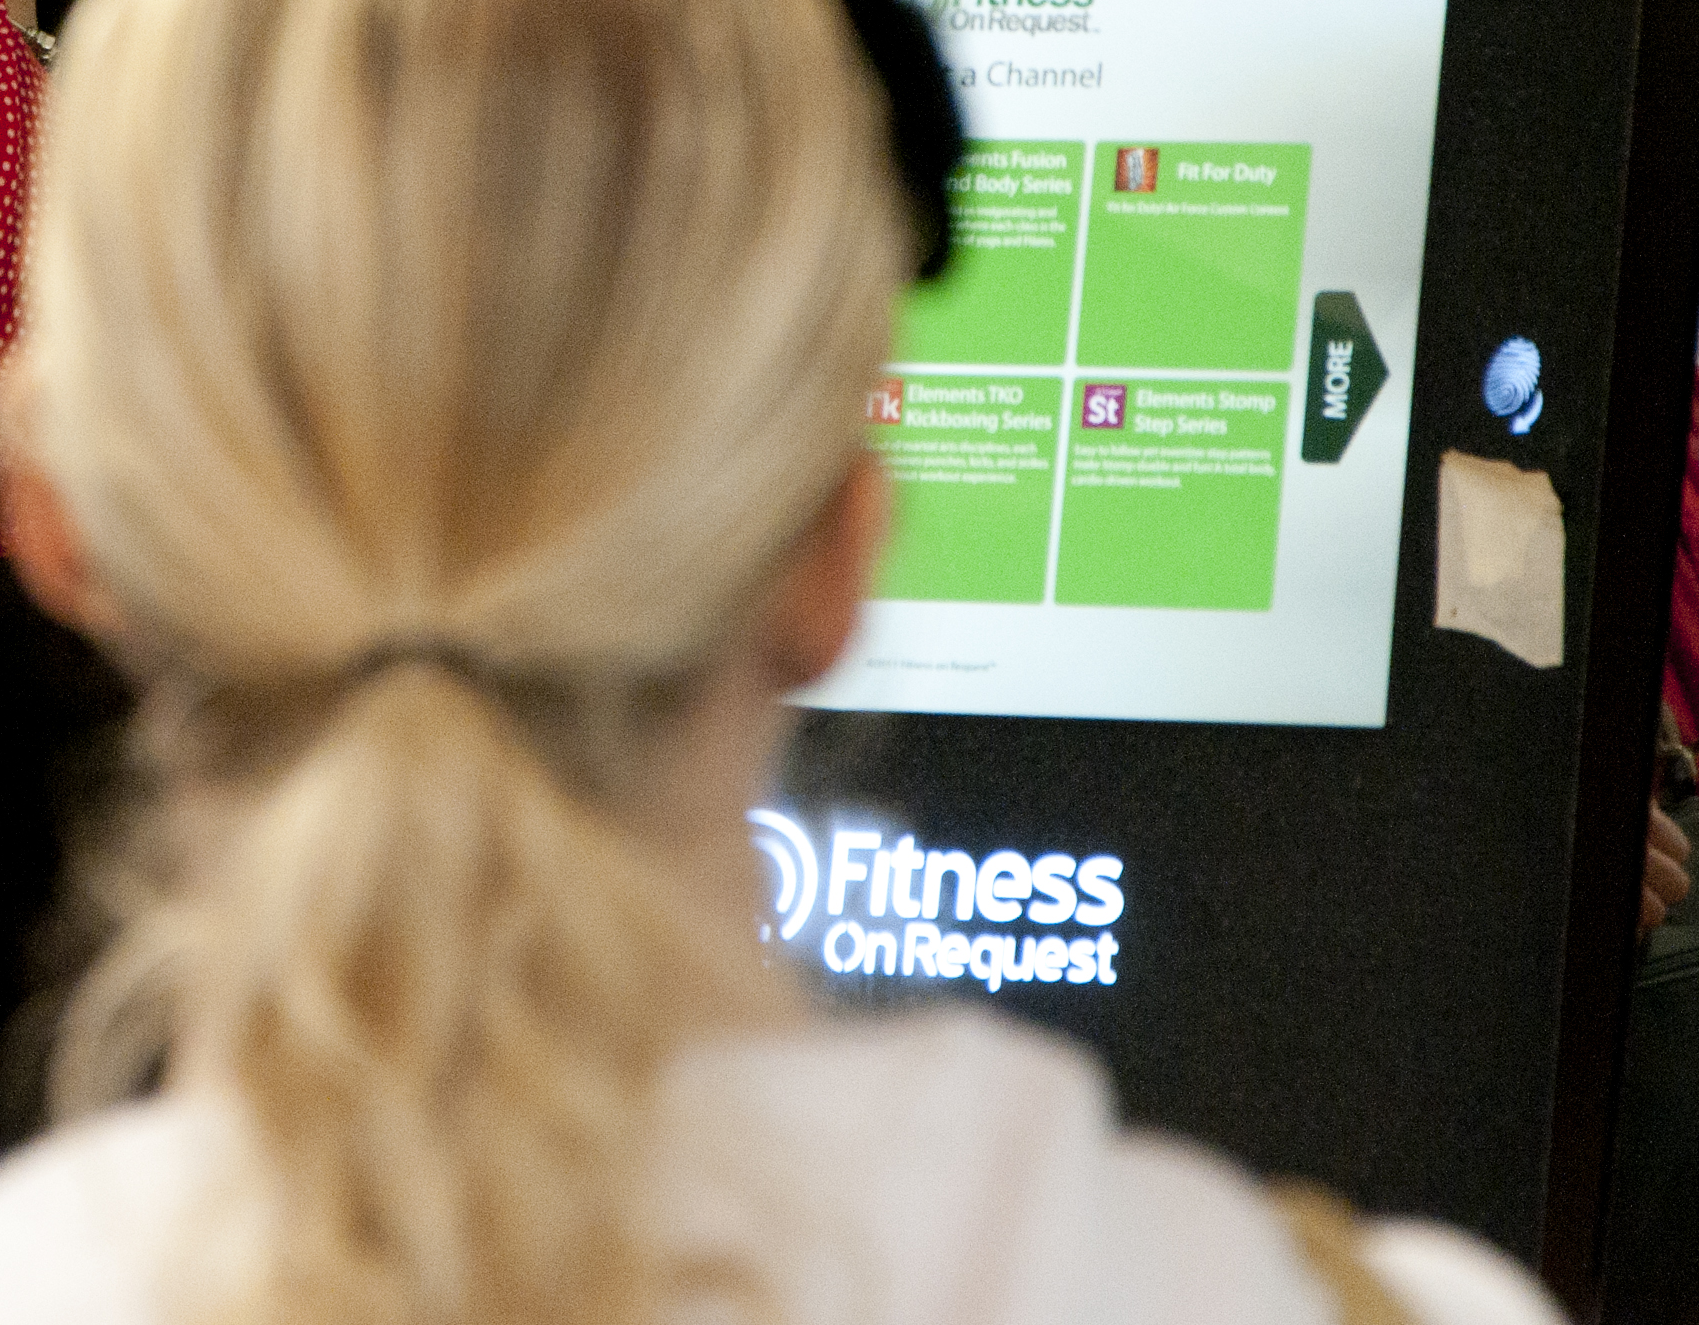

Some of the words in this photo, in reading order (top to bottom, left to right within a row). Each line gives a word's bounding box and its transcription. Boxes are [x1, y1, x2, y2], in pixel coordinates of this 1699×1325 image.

[961, 69, 976, 87] a
[987, 61, 1103, 88] Channel
[1011, 150, 1067, 170] Fusion
[975, 173, 1020, 198] Body
[1022, 174, 1073, 195] Series
[1178, 161, 1199, 181] Fit
[1202, 161, 1230, 182] For
[1234, 162, 1277, 187] Duty
[1322, 339, 1353, 420] MORE
[907, 383, 985, 404] Elements
[988, 384, 1024, 405] TKO
[1136, 388, 1214, 410] Elements
[1218, 390, 1276, 414] Stomp
[906, 409, 998, 433] Kickboxing
[1002, 410, 1052, 431] Series
[1087, 394, 1120, 425] St
[1134, 414, 1174, 437] Step
[1177, 414, 1228, 435] Series
[827, 830, 1125, 927] Fitness
